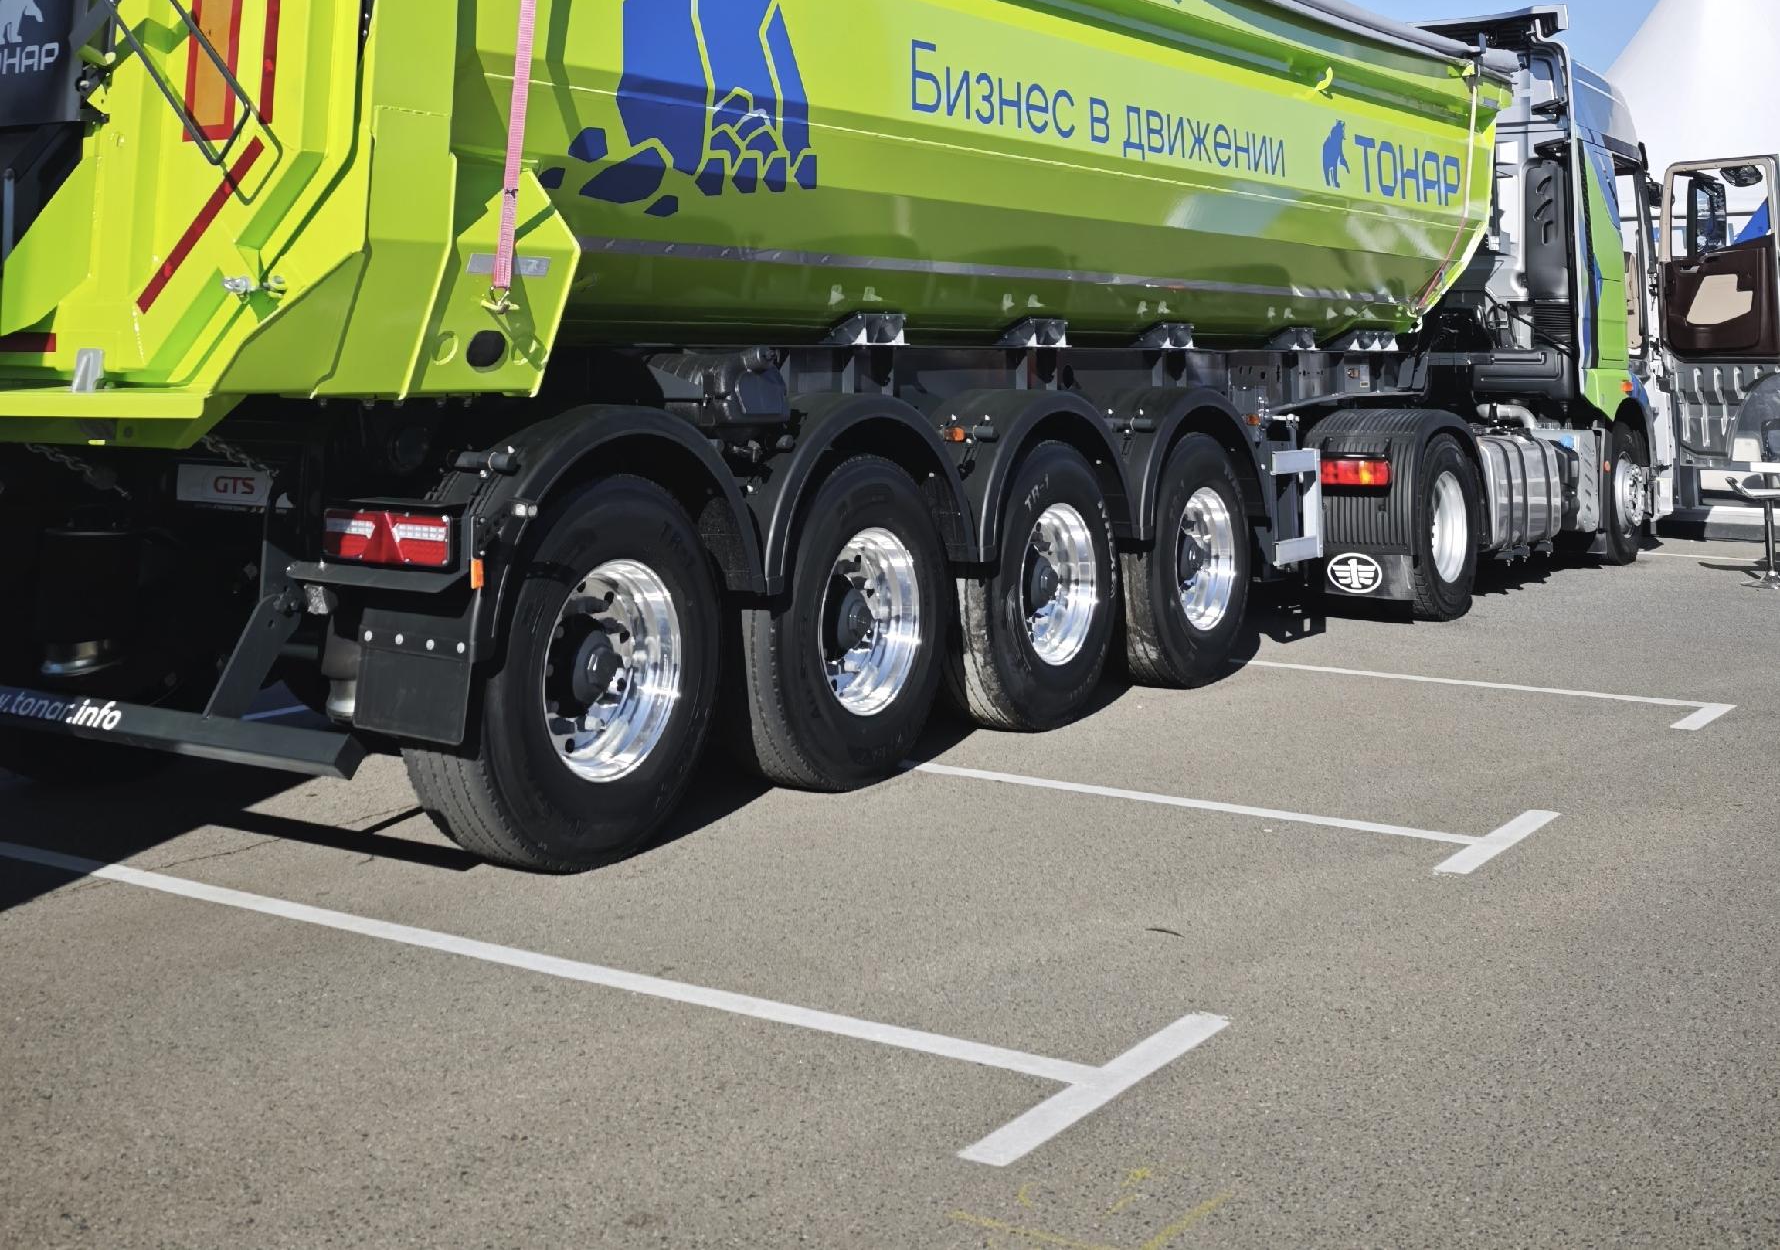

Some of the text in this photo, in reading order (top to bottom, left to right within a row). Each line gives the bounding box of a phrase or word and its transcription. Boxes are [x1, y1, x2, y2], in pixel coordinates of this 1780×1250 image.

[0, 41, 60, 75] НАР
[910, 38, 1286, 178] Бизнес в движении
[1353, 133, 1461, 207] ТОНАР
[213, 476, 256, 495] GTS
